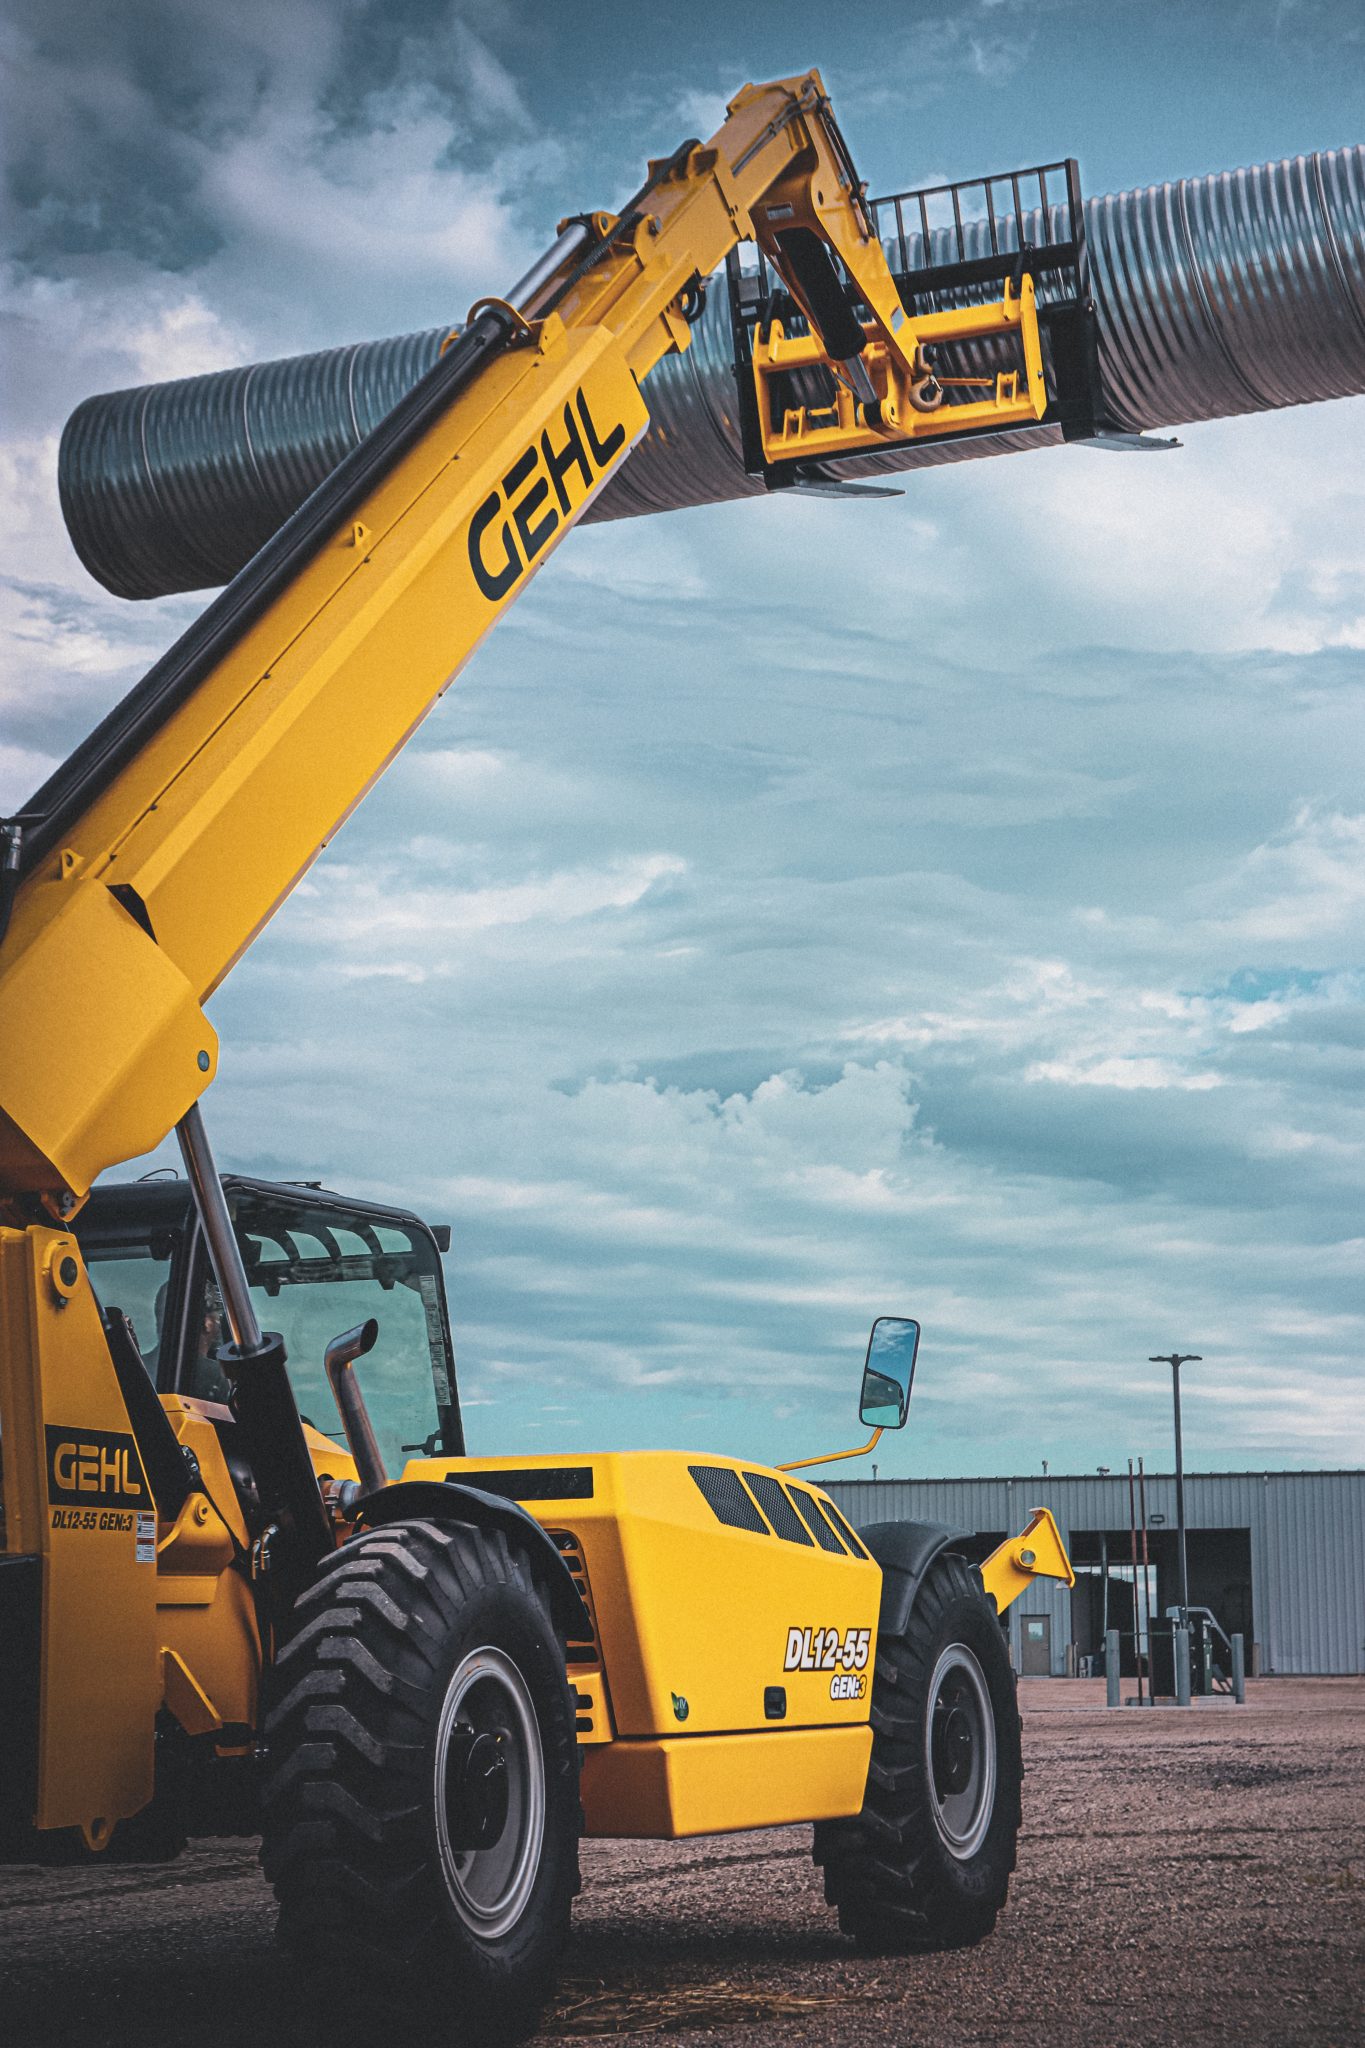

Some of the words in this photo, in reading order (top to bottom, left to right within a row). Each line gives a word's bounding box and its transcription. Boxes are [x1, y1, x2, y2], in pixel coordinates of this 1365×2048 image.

[468, 386, 625, 601] GEHL
[54, 1443, 141, 1494] GEHL
[51, 1510, 97, 1530] DL12-55
[99, 1512, 133, 1531] GEN:3
[783, 1627, 872, 1672] DL12-55
[830, 1674, 868, 1700] GEN:3
